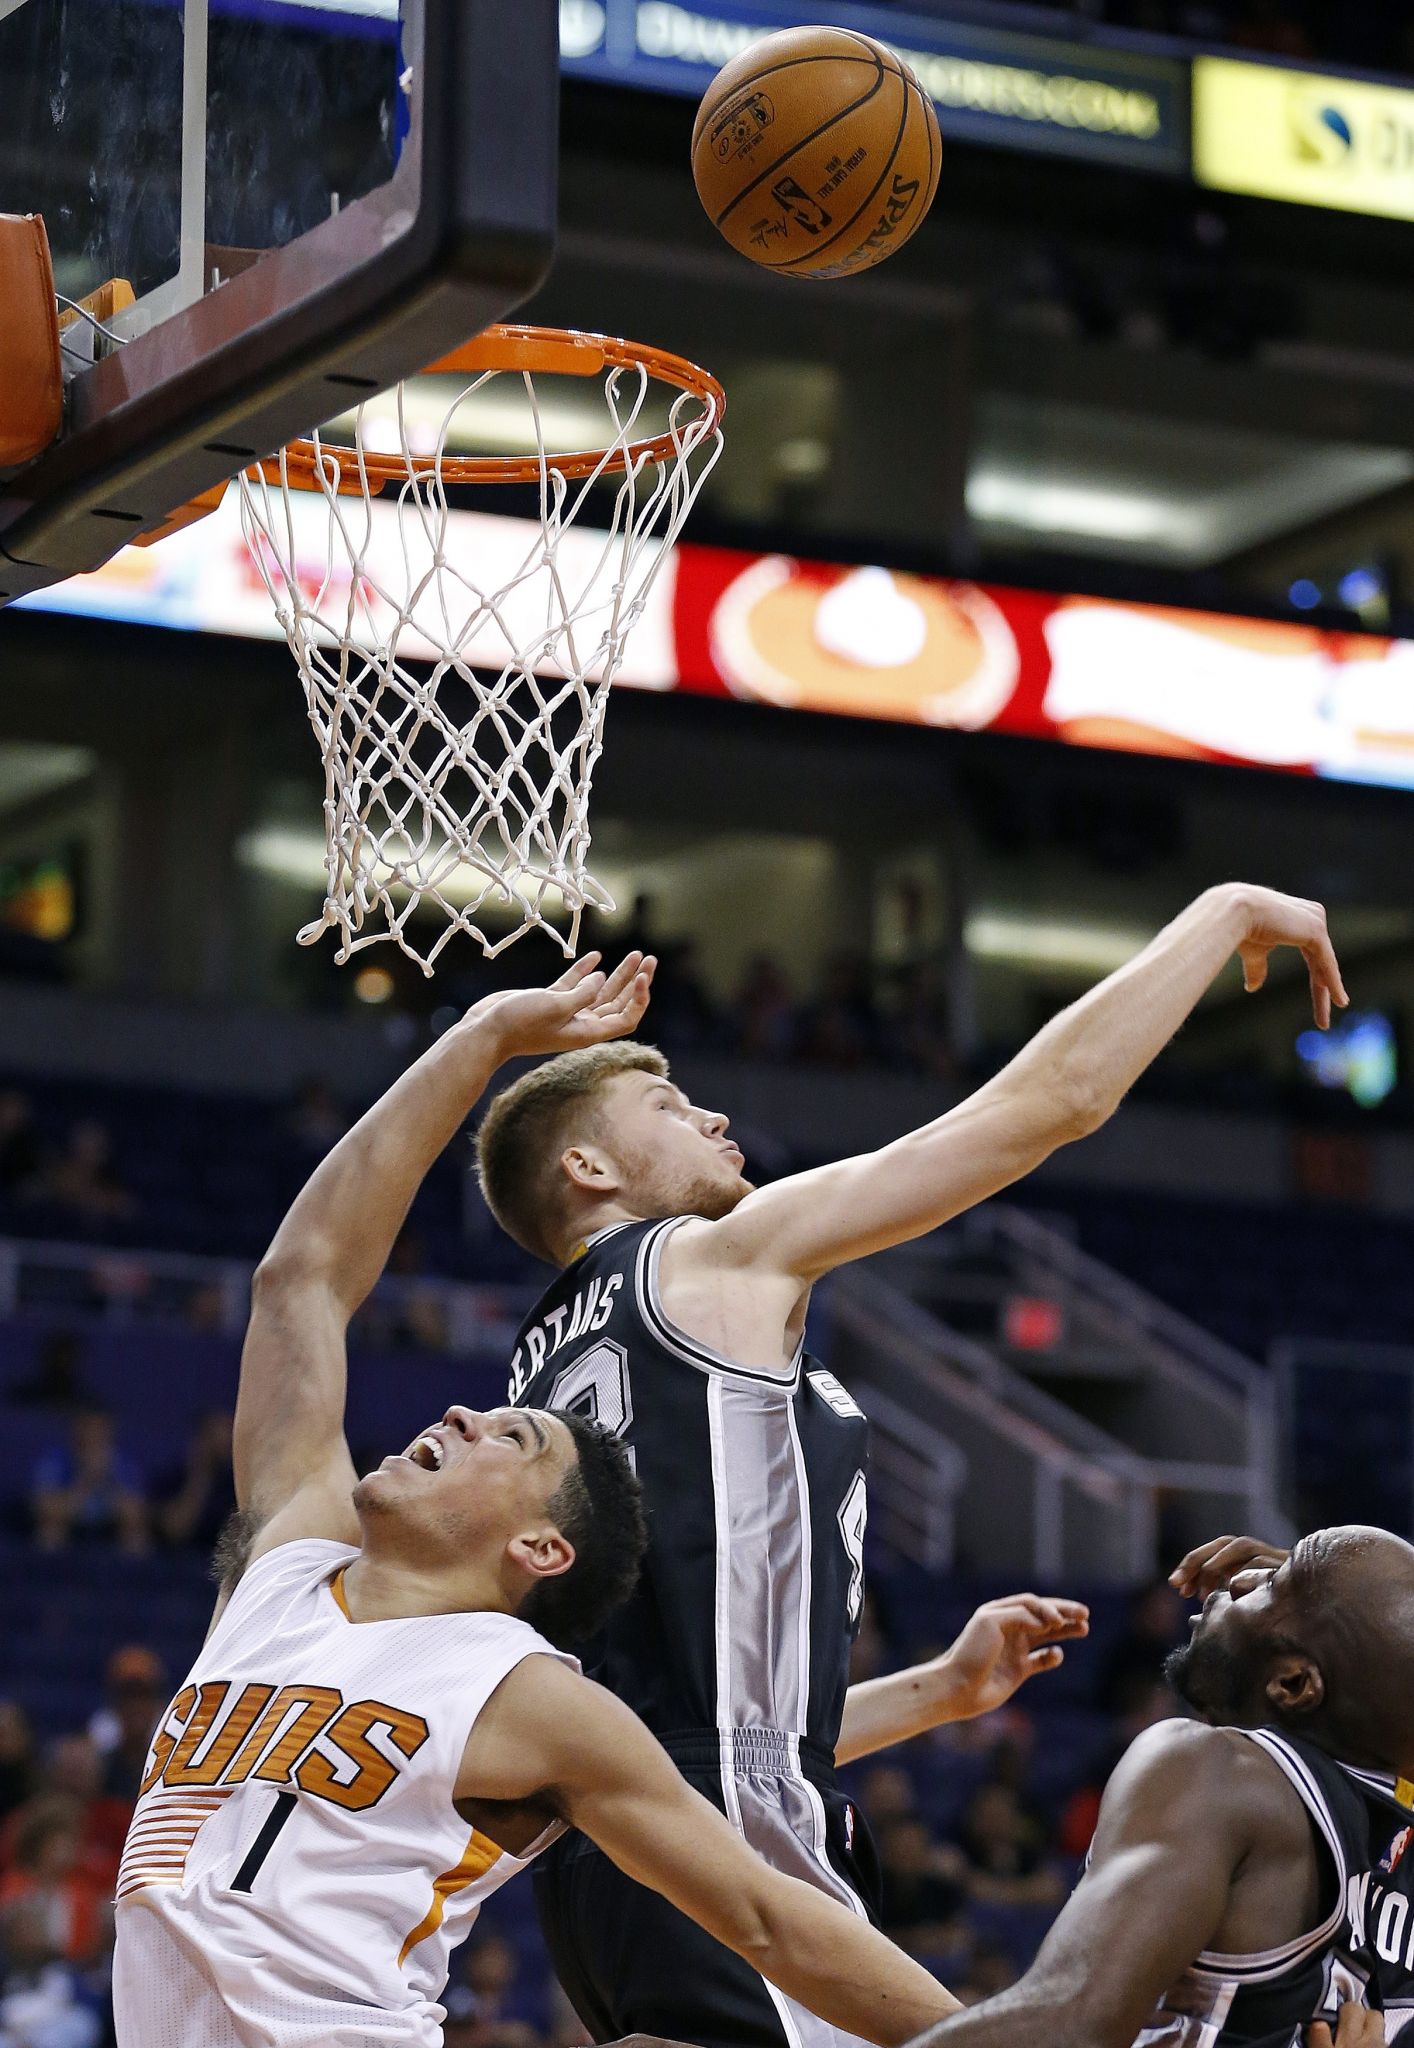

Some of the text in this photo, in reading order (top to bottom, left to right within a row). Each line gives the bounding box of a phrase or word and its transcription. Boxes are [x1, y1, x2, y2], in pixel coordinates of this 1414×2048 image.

[816, 147, 868, 199] OFFICIAL GAME BALL
[809, 173, 920, 278] SPALD
[139, 1680, 430, 1812] SUNS
[229, 1790, 299, 1894] 1
